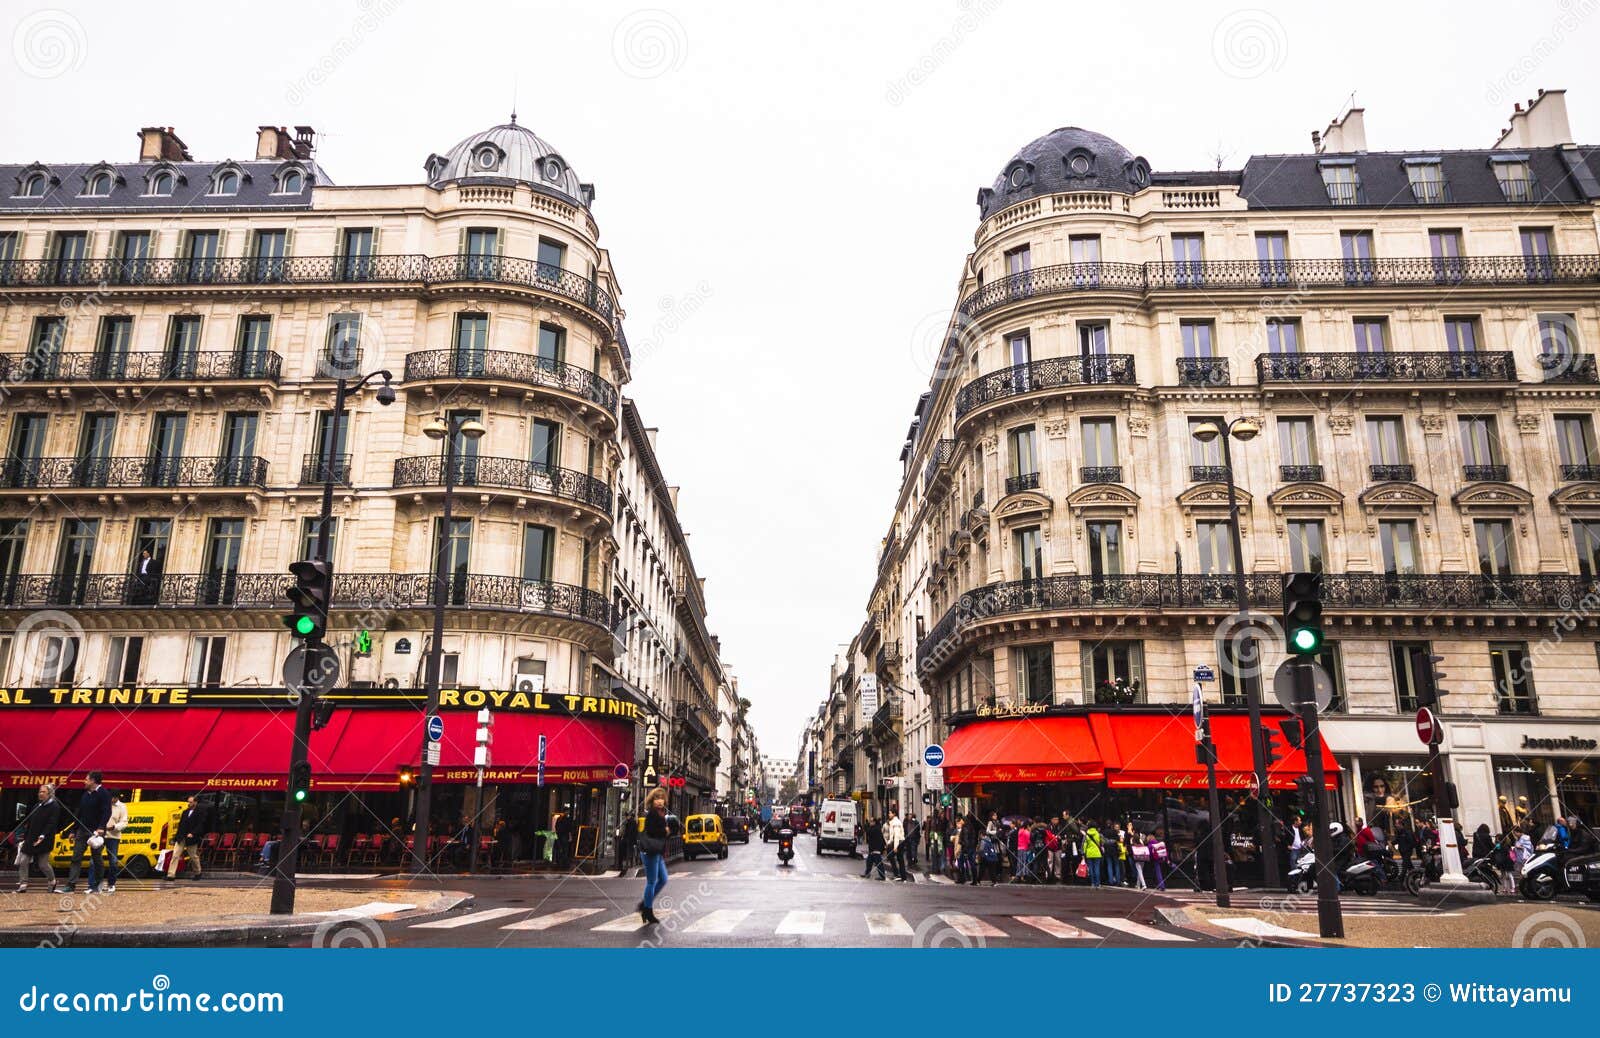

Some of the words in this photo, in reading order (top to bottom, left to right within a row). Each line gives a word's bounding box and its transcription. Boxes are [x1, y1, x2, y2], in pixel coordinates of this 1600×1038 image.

[50, 689, 189, 704] TRINITE
[439, 690, 550, 709] ROYAL
[564, 695, 638, 718] TRINITE
[644, 714, 659, 787] MARTIAL
[11, 776, 69, 785] TRINITE
[563, 769, 589, 780] ROYAL
[1164, 774, 1191, 788] Café
[207, 779, 279, 787] RESTAURANT
